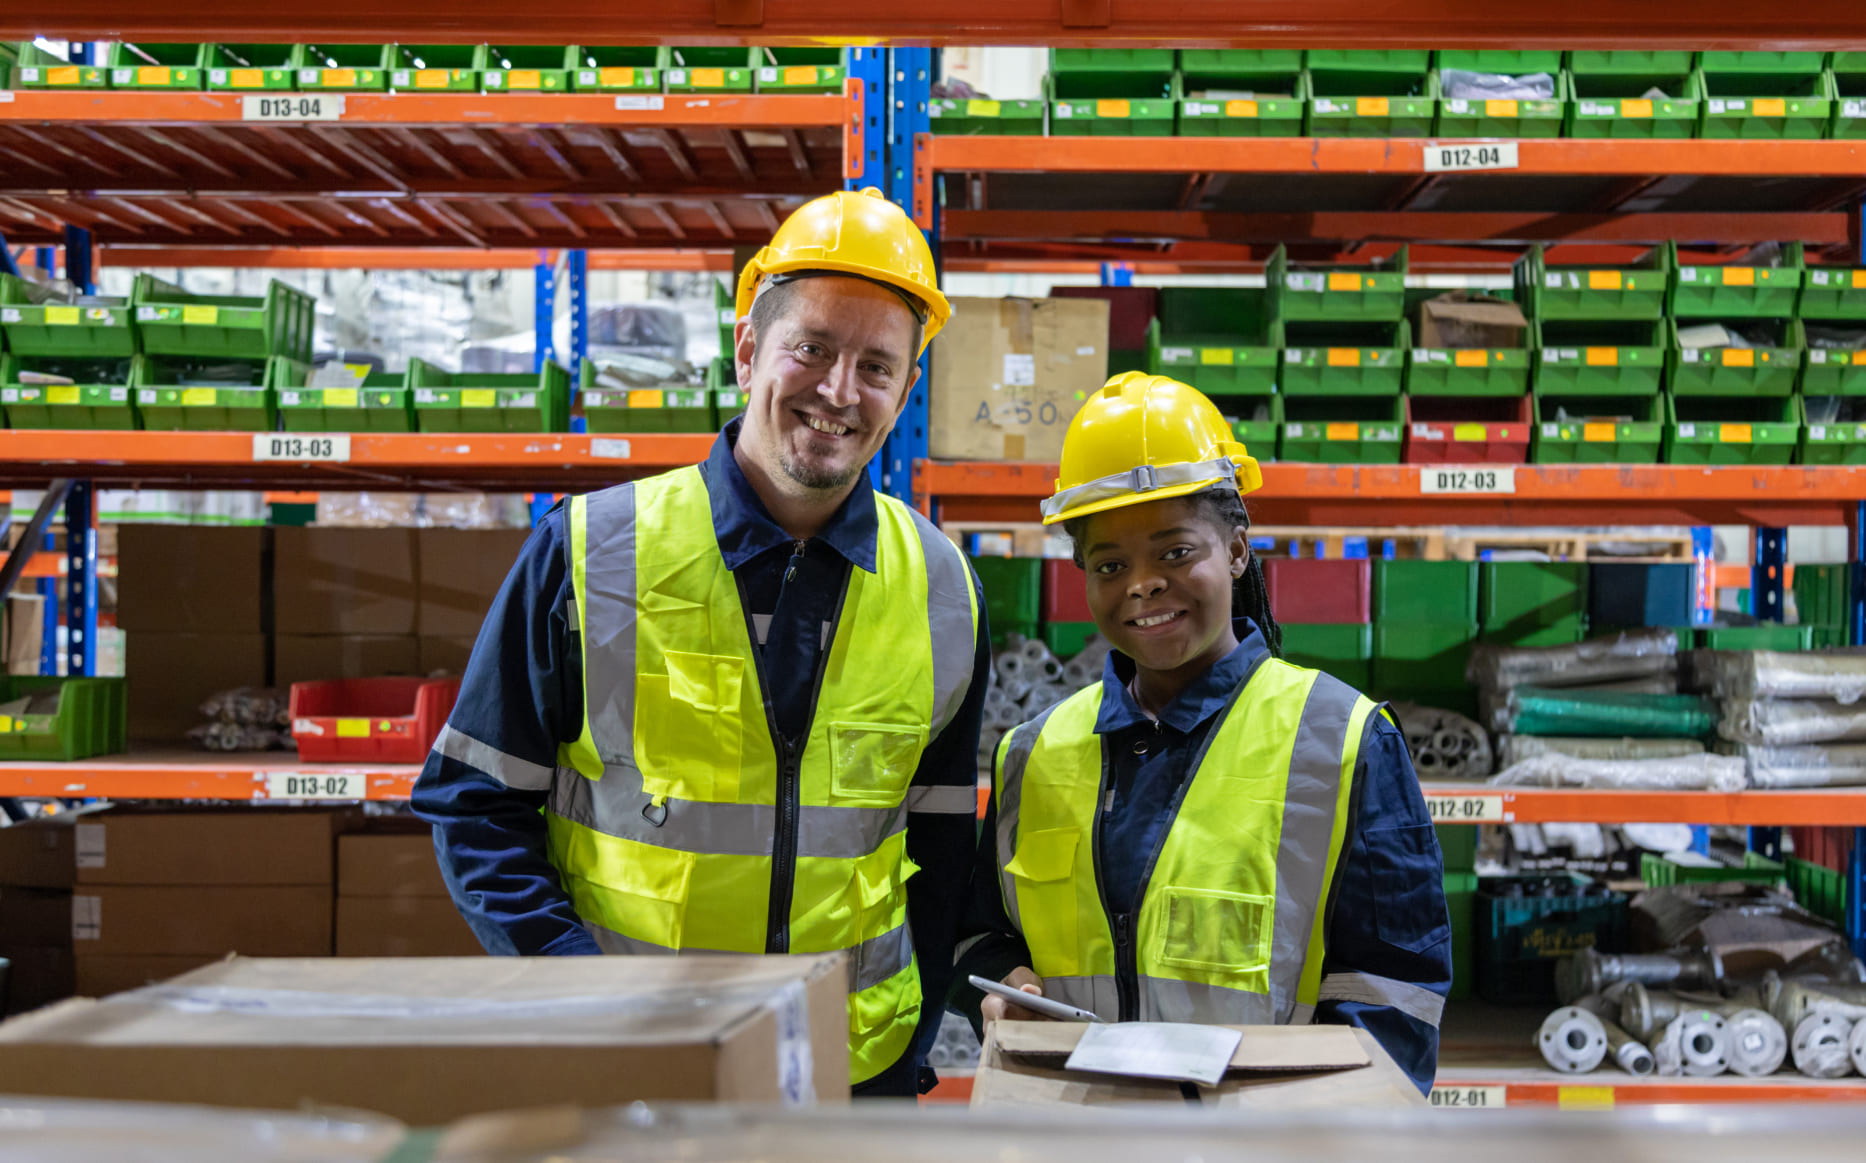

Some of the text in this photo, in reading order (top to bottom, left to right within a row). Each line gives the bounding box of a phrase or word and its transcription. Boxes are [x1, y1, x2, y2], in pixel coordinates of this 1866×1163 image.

[260, 98, 321, 117] D13-04
[1441, 147, 1500, 168] D12-04
[271, 439, 332, 457] D13-03
[1437, 472, 1496, 489] D12-03
[287, 777, 348, 795] D13-02
[1431, 1090, 1486, 1106] D12-01
